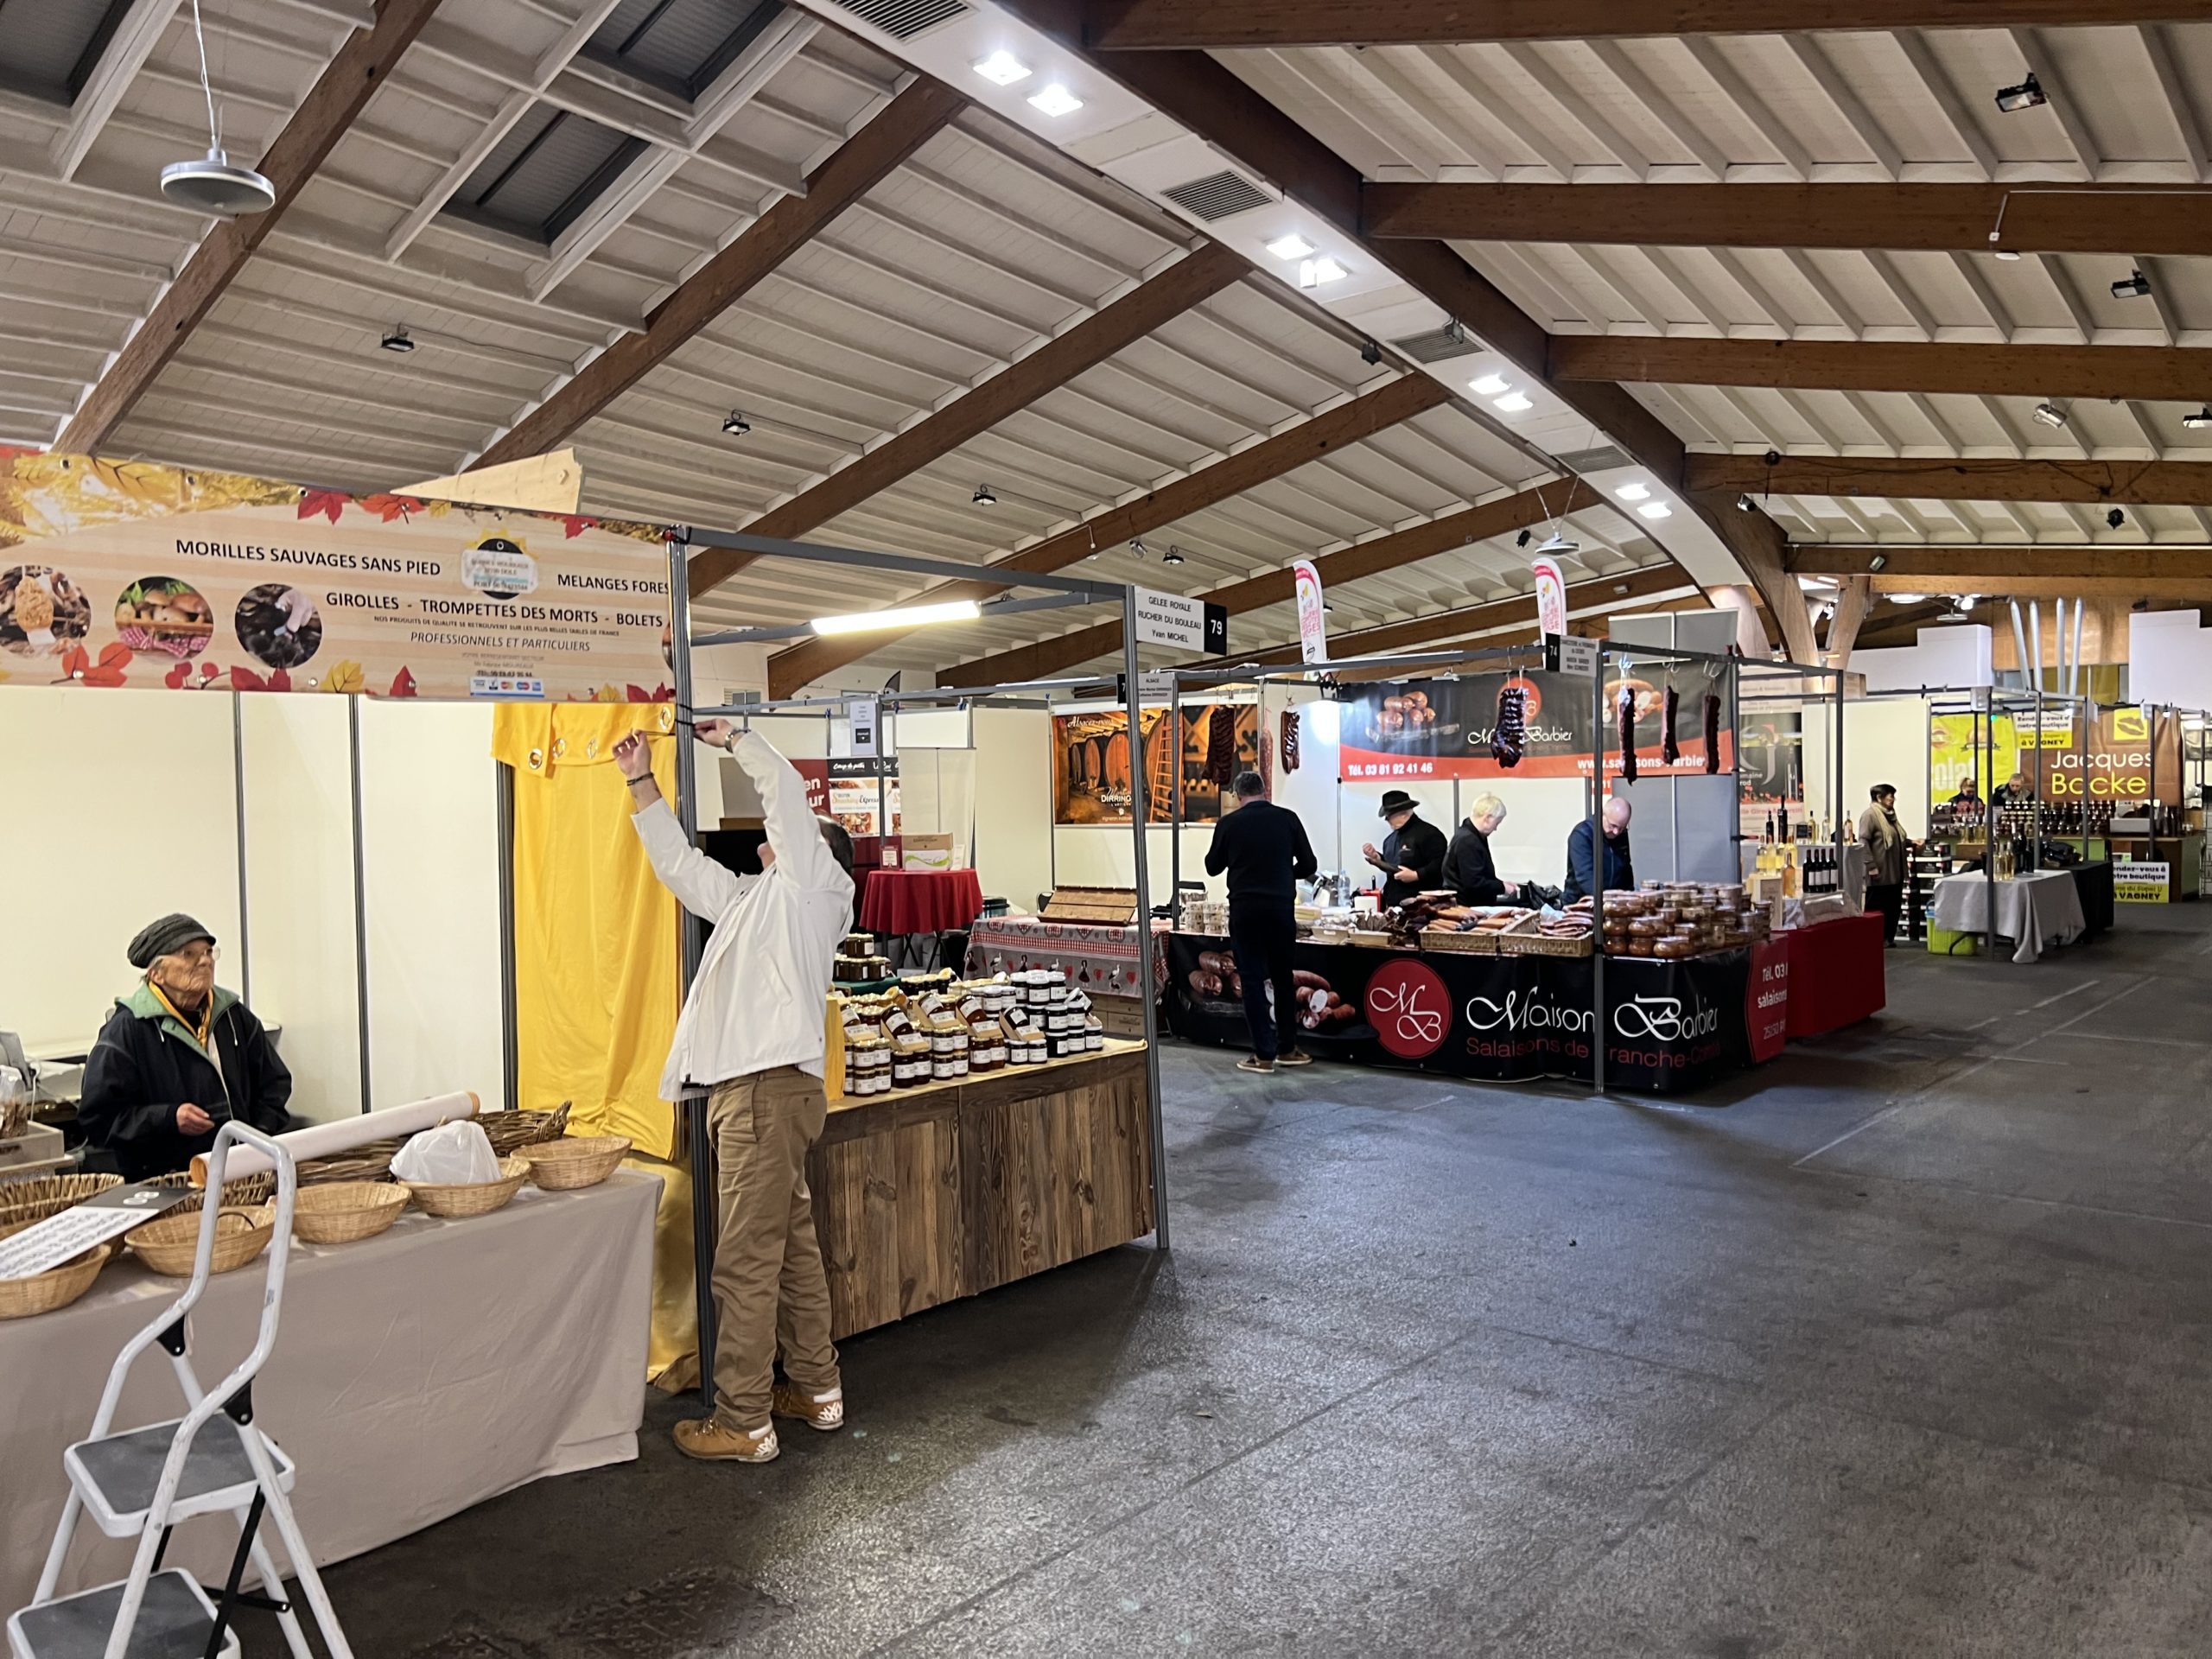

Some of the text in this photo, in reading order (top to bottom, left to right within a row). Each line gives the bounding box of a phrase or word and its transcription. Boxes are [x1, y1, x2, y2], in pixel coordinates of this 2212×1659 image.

[175, 539, 441, 575] MORILLES SAUVAGES SANS PIED
[557, 574, 628, 591] MELANGES
[326, 592, 399, 610] GIROLLES
[420, 599, 517, 618] TROMPETTES
[521, 606, 546, 620] DES
[550, 608, 598, 623] MORTS
[616, 613, 663, 627] BOLETS
[1148, 596, 1192, 613] GELEE ROYALE
[390, 616, 421, 625] PRODUITS
[432, 619, 457, 627] QUALITE
[467, 621, 508, 630] RETROUVENT
[1138, 610, 1202, 630] RUCHER DU BOULEAU
[1211, 619, 1223, 635] 79
[410, 631, 590, 652] PROFESSIONNELS ET PARTICULIERS
[1152, 629, 1189, 643] Yvan MICHEL
[1522, 726, 1573, 742] Barbier
[1348, 762, 1433, 776] Tél. 03 81 92 41 46
[2050, 750, 2152, 772] Jacques
[1101, 794, 1132, 803] DIRRING
[2129, 874, 2166, 882] boutique
[1775, 963, 1785, 979] 03
[1466, 985, 1718, 1041] Maison Barbier
[1465, 1037, 1560, 1058] Salaisons
[1565, 1039, 1589, 1058] de
